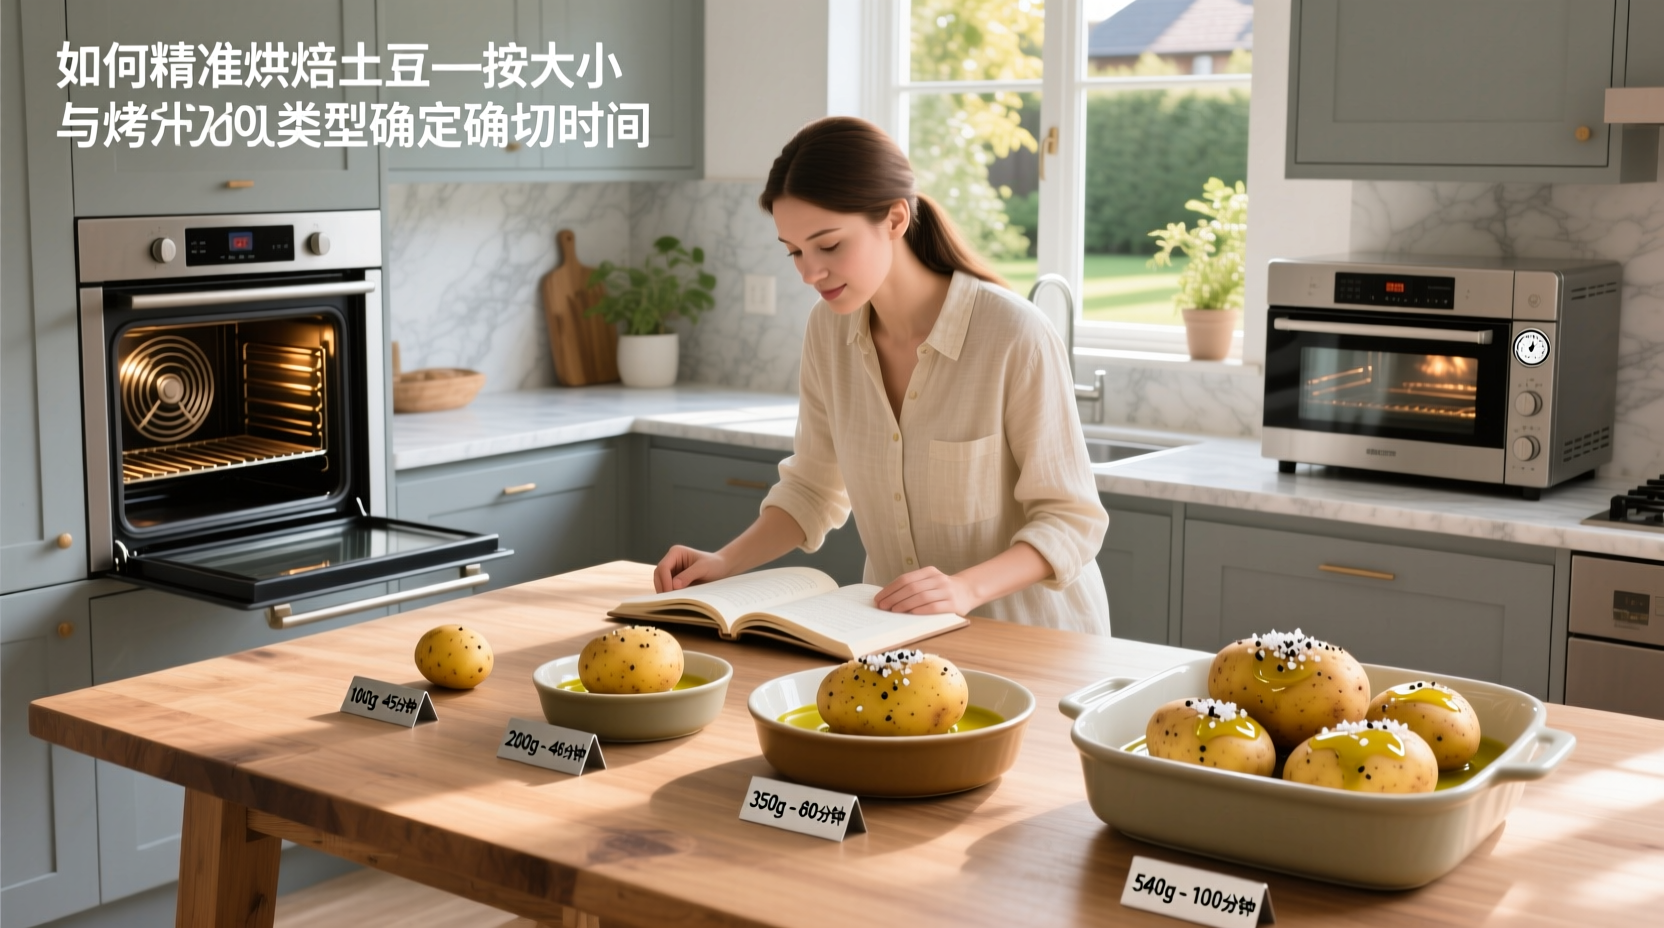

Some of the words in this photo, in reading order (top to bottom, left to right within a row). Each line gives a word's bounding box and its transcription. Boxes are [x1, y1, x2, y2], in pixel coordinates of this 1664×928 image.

[504, 729, 540, 756] 200g
[749, 790, 787, 819] 350g
[1132, 873, 1177, 904] 540g
